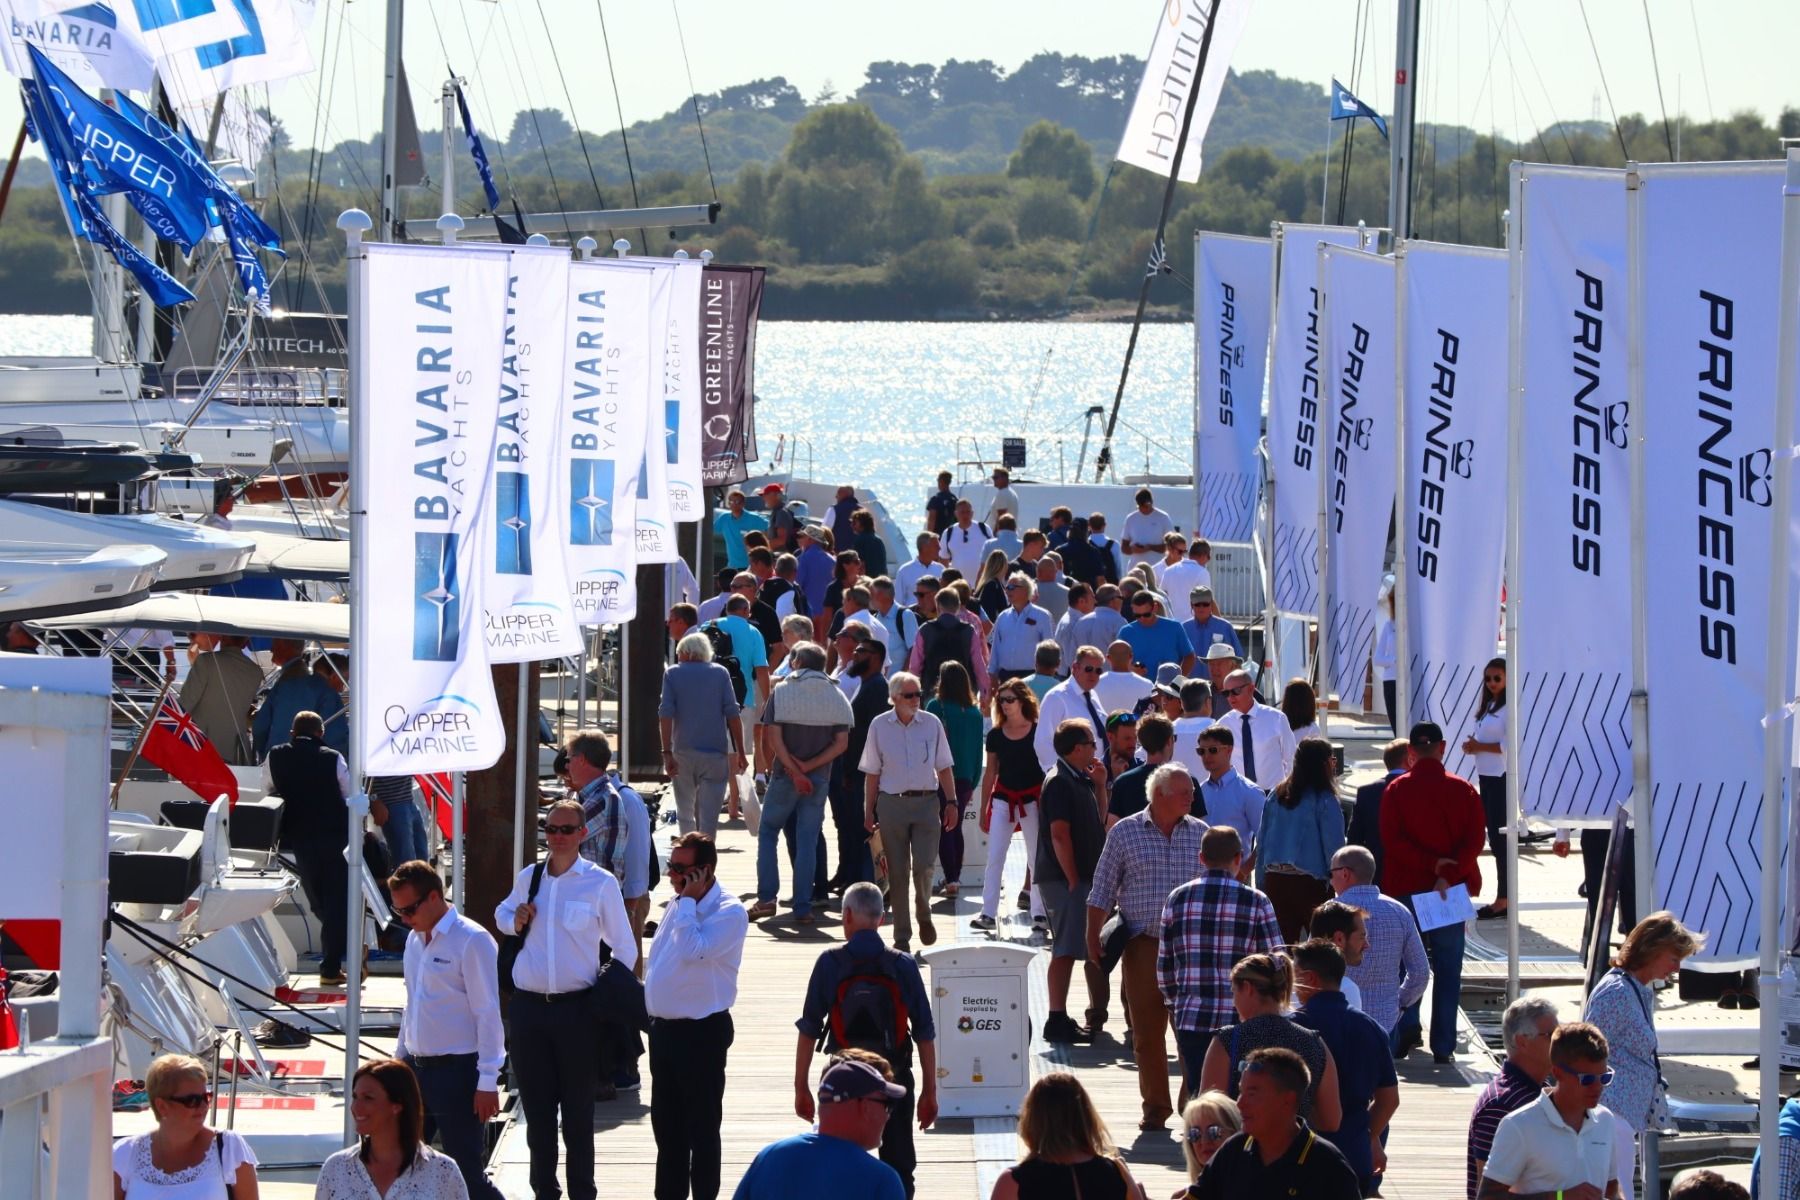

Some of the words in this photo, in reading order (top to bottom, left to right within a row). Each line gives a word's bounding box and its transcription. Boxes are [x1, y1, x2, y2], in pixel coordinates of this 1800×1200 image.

[11, 15, 112, 50] BAVARIA
[571, 289, 606, 451] BAVARIA
[669, 319, 681, 394] YACHTS
[705, 279, 723, 405] GREENLINE
[726, 323, 735, 361] YACHTS
[1220, 282, 1235, 427] PRINCESS
[414, 285, 453, 519] BAVARIA
[519, 342, 531, 463] YACHTS
[603, 346, 621, 452] YACHTS
[1572, 268, 1604, 577] PRINCESS
[450, 369, 473, 519] YACHTS
[702, 459, 735, 470] LIPPER
[1417, 328, 1459, 583] PRINCESS
[1698, 289, 1737, 665] PRINCESS
[485, 609, 555, 631] LIPPER
[575, 597, 618, 612] ARINE
[384, 704, 471, 733] CLIPPER
[390, 735, 479, 755] MARINE
[964, 811, 976, 820] ES
[962, 996, 998, 1005] Electrics
[975, 1020, 1001, 1031] GES
